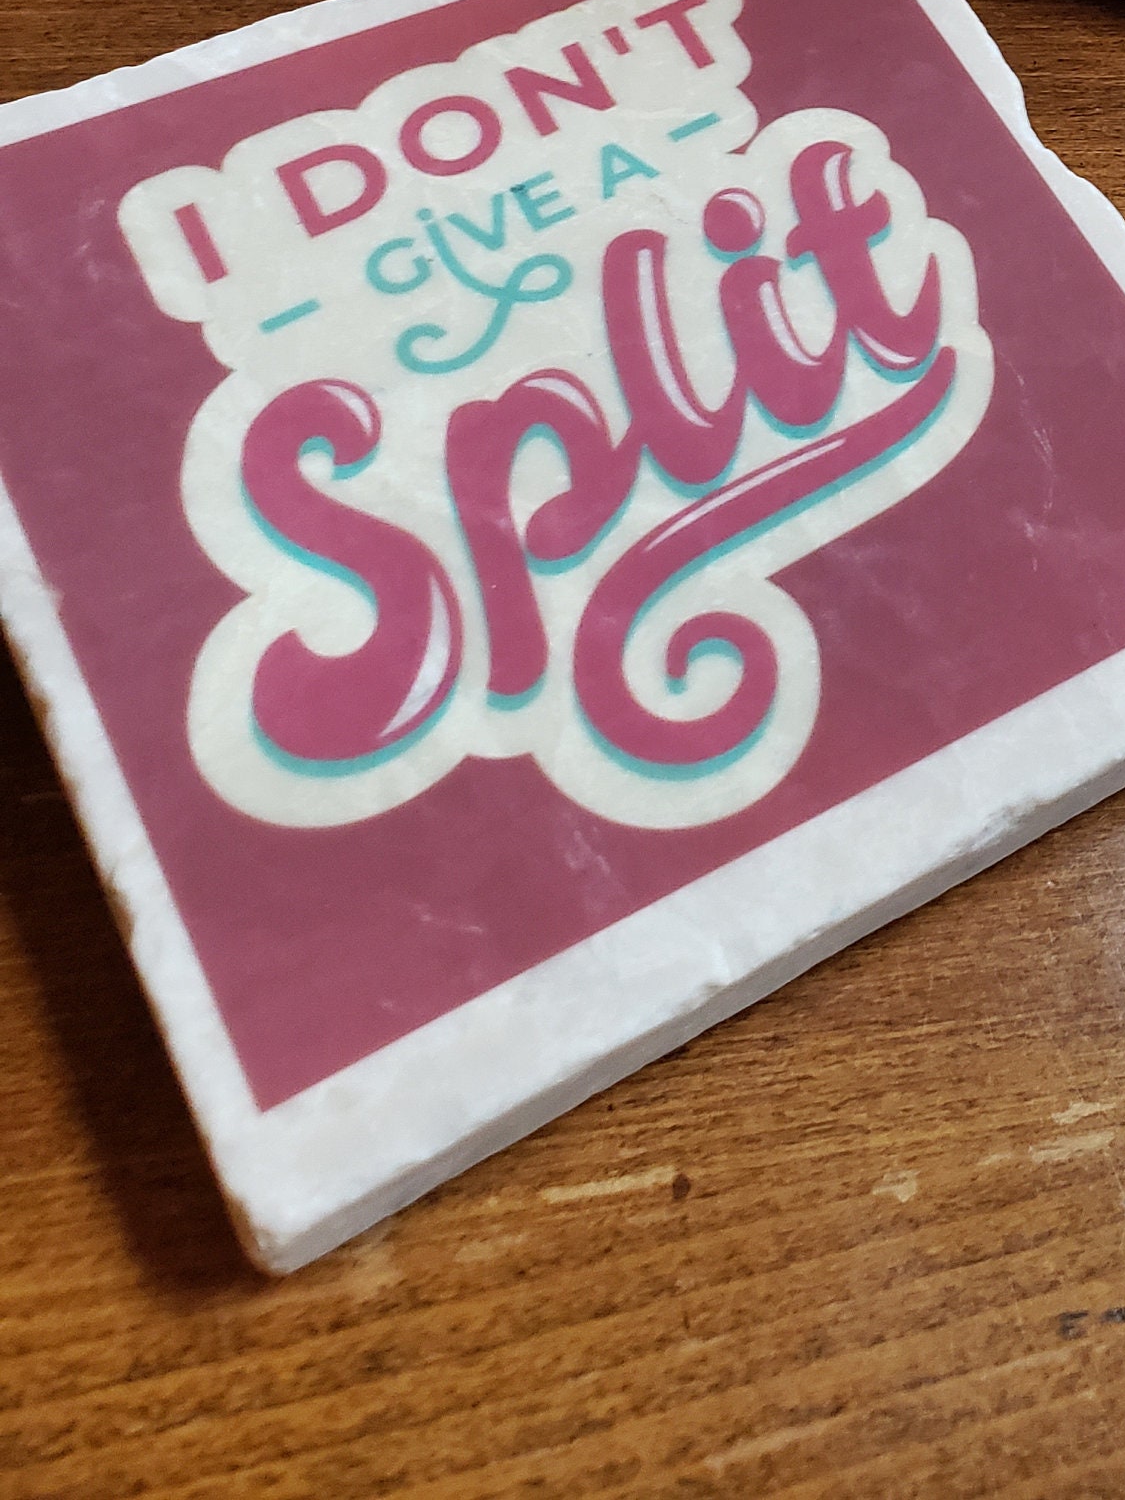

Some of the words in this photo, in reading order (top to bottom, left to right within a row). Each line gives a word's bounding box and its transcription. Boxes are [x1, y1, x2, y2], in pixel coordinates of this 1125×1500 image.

[600, 143, 661, 199] A
[175, 204, 229, 283] I
[240, 141, 956, 778] Split
